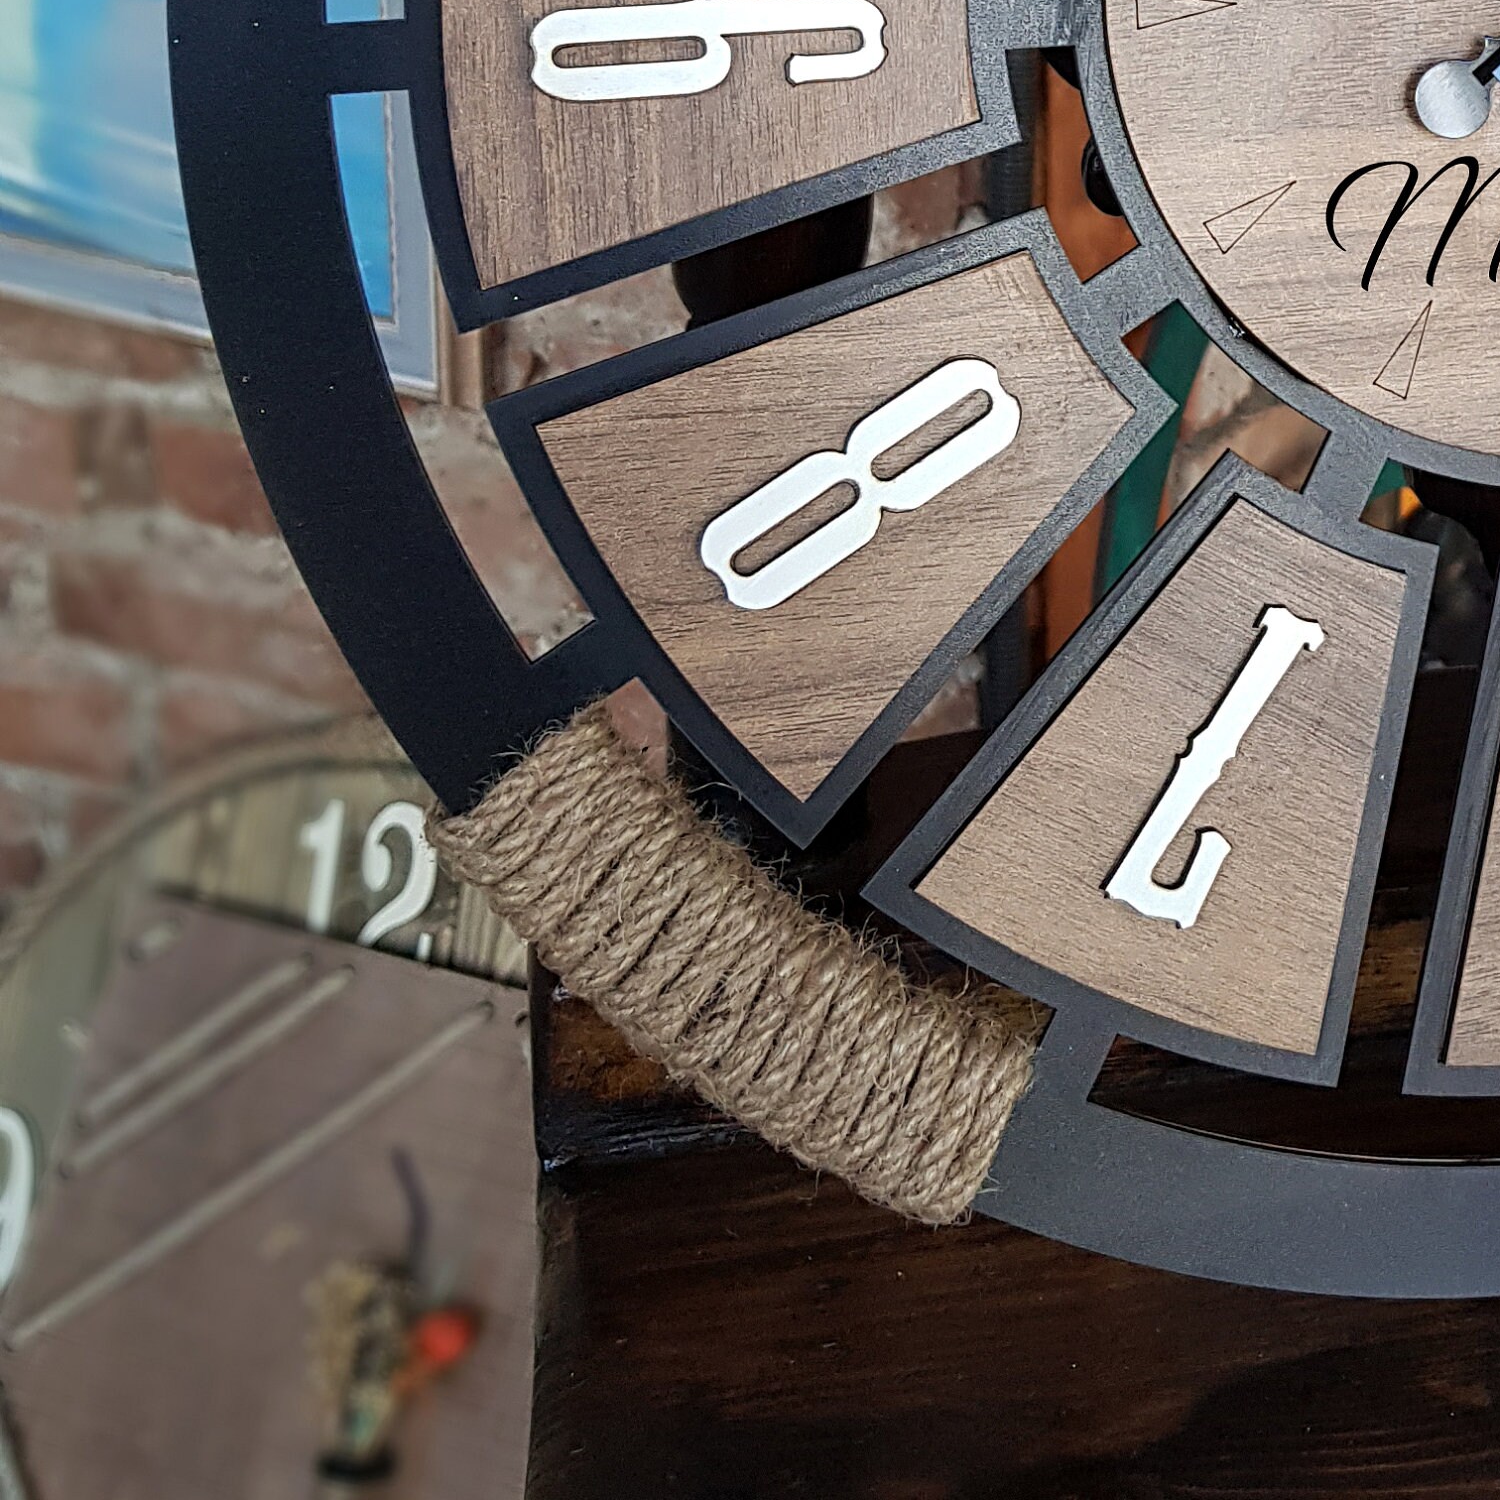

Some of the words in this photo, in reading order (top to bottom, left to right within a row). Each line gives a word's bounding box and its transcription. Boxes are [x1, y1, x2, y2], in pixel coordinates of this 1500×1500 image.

[700, 357, 1020, 611] 8
[300, 800, 438, 962] 12
[1103, 605, 1325, 930] 7
